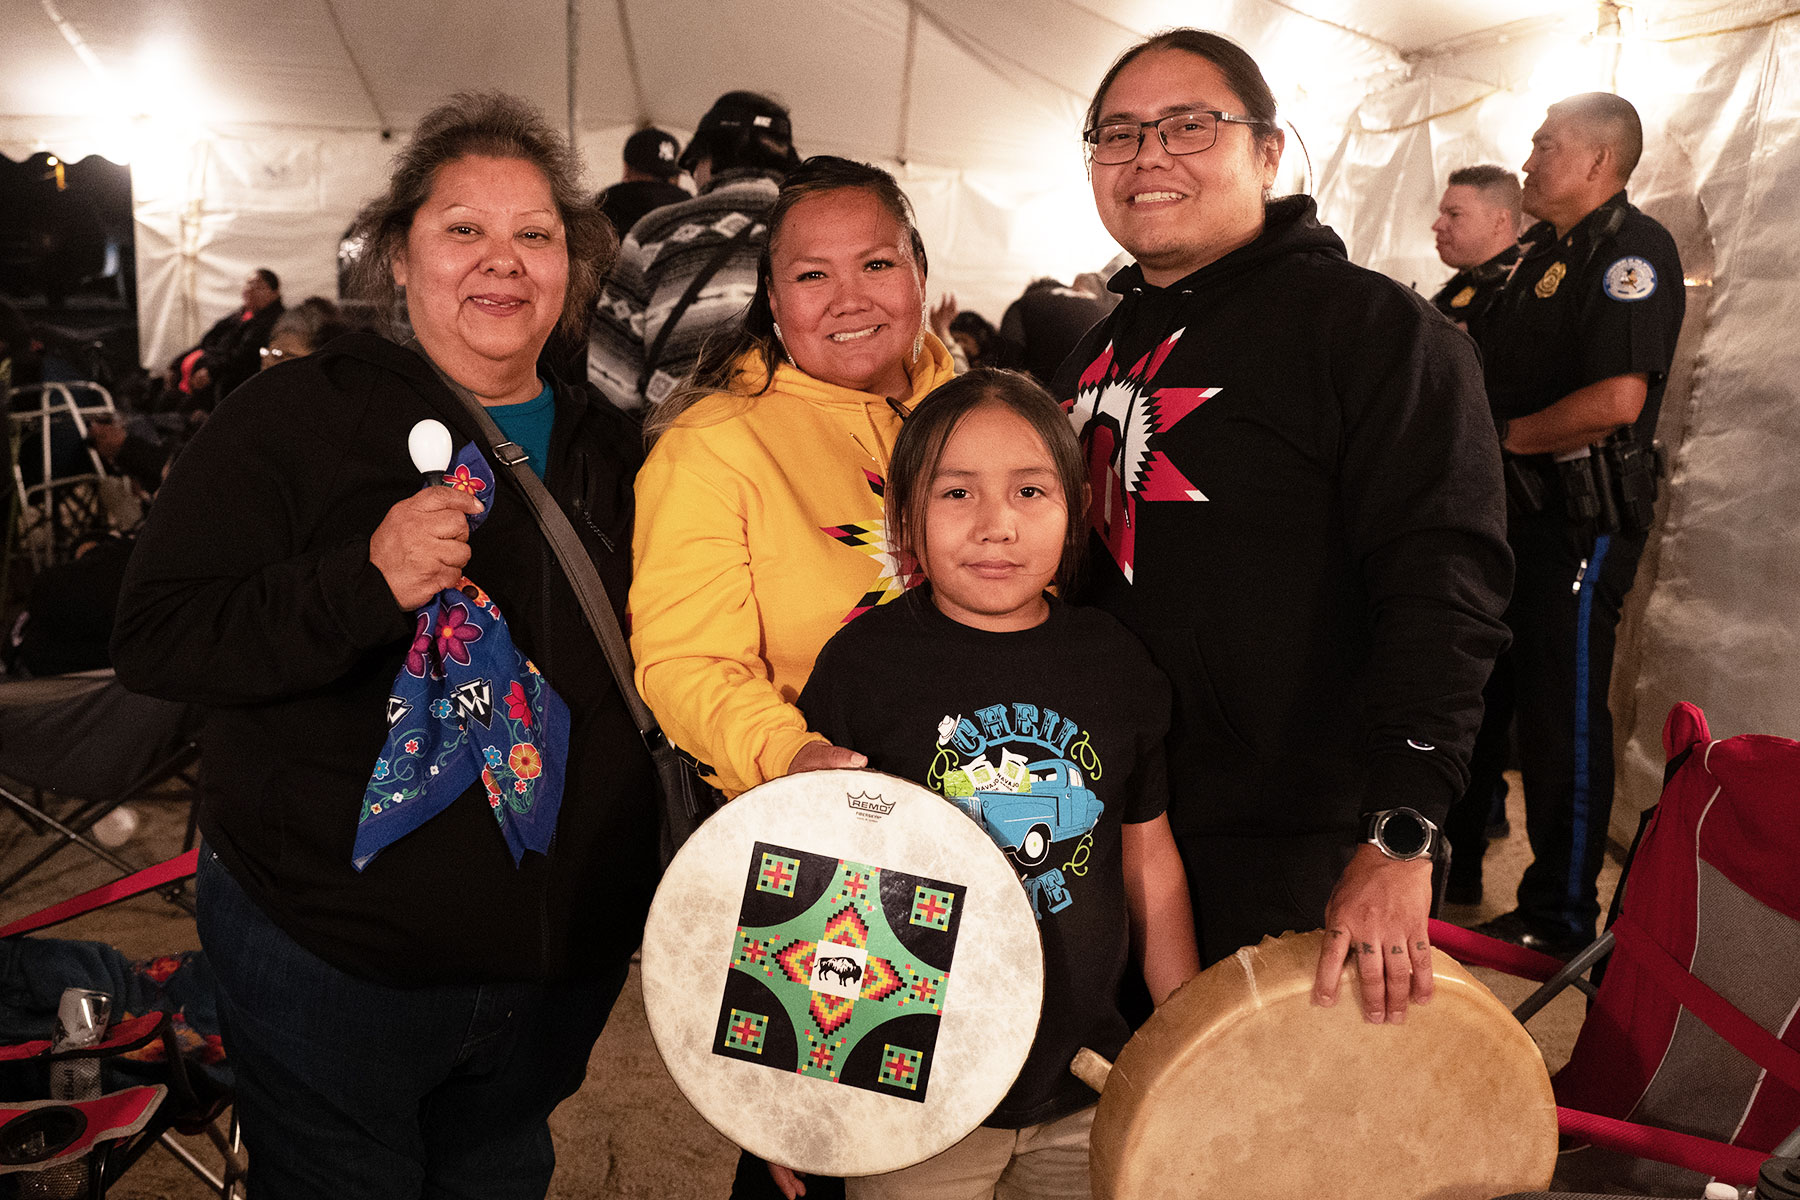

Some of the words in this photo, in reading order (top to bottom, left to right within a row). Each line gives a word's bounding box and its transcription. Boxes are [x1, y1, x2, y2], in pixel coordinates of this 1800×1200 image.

[951, 702, 1079, 758] CHEII
[975, 778, 1000, 791] NAVAJO
[996, 772, 1020, 788] NAVAJO
[852, 799, 888, 812] REMO
